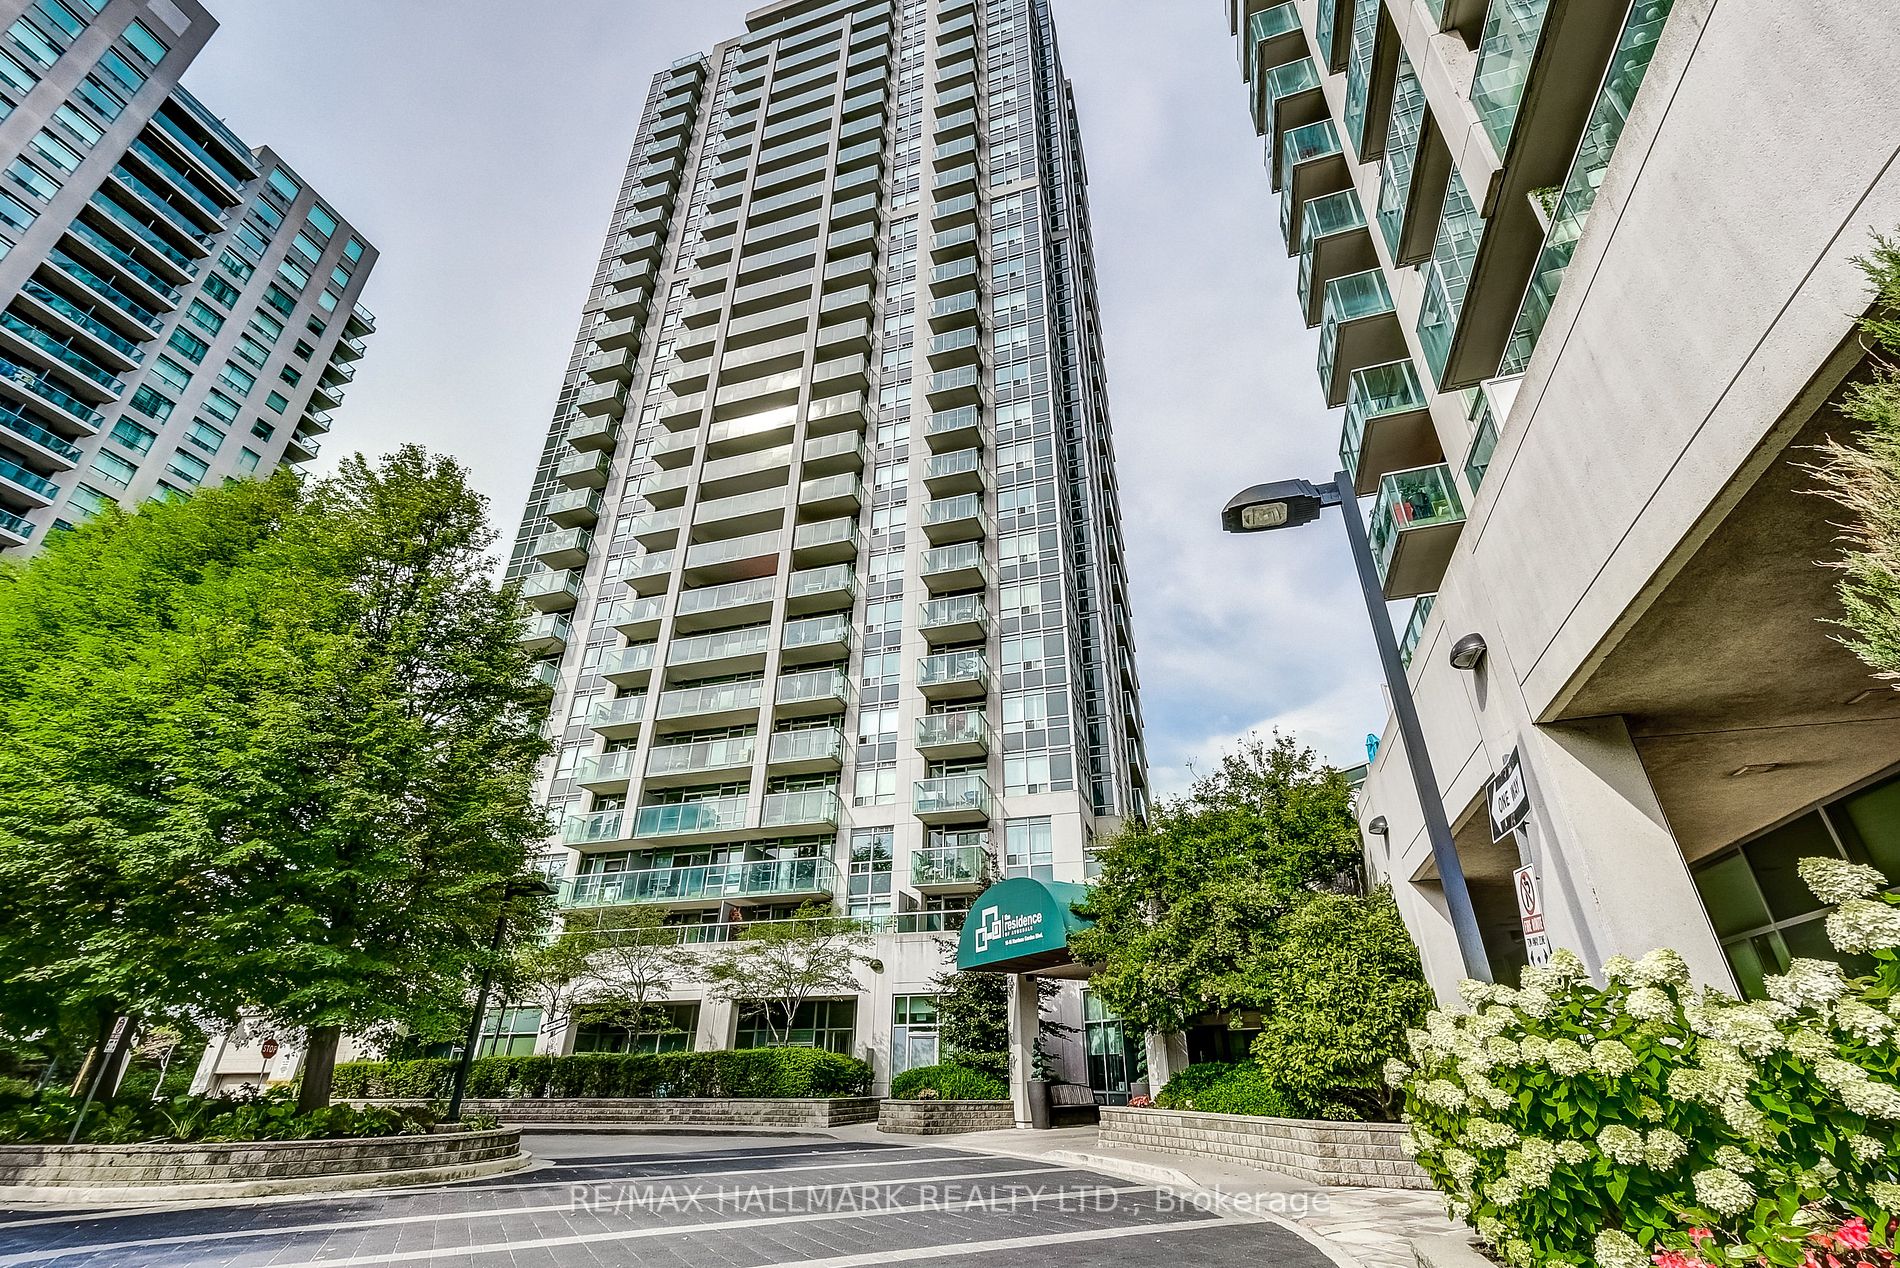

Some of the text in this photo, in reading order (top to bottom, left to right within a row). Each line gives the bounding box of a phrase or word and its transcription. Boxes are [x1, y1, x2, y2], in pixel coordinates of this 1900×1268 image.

[1498, 776, 1521, 813] ONE WAY
[1005, 912, 1042, 931] residence
[262, 1044, 278, 1053] STOP
